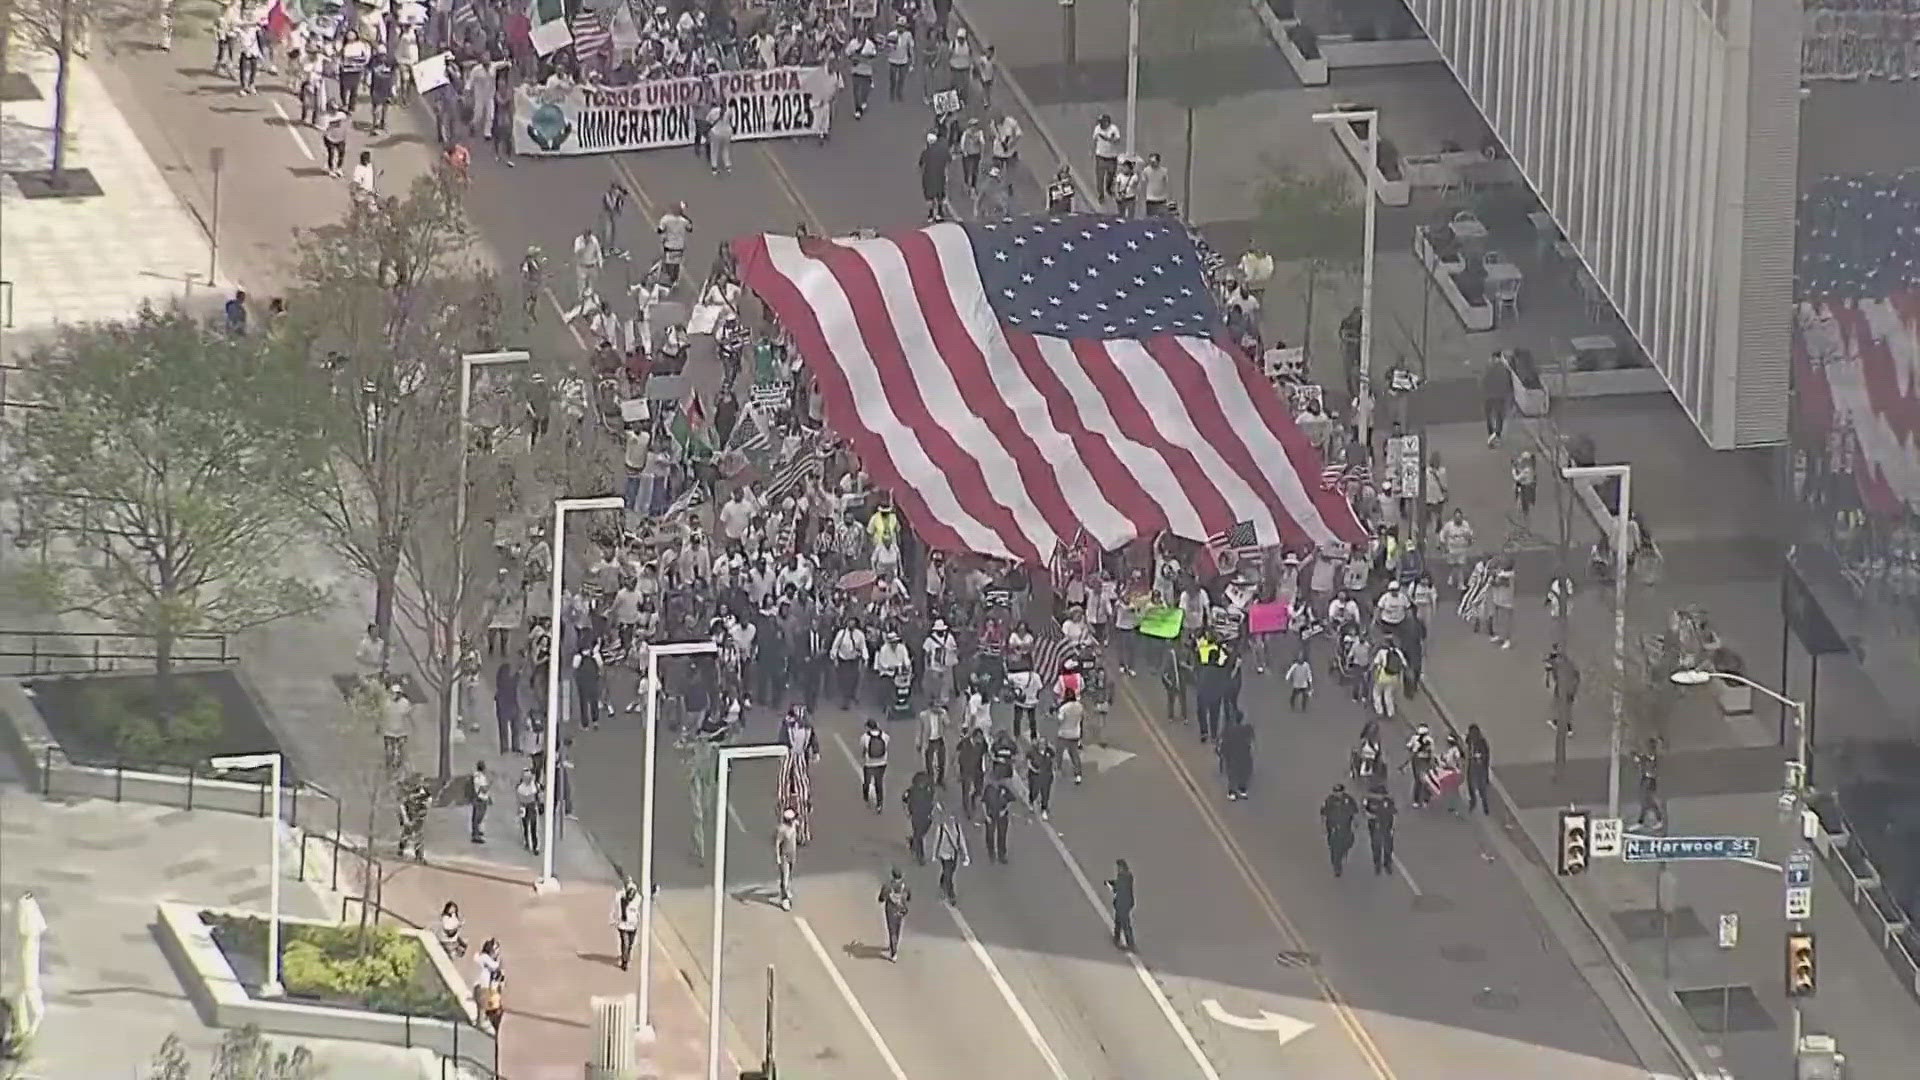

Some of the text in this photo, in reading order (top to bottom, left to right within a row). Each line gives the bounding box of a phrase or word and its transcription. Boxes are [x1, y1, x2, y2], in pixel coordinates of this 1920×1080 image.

[583, 71, 801, 107] TODOS UNIDO POR UNA
[578, 105, 690, 148] IMMIGRATION
[771, 92, 815, 131] 2025
[1650, 840, 1724, 853] Harwood
